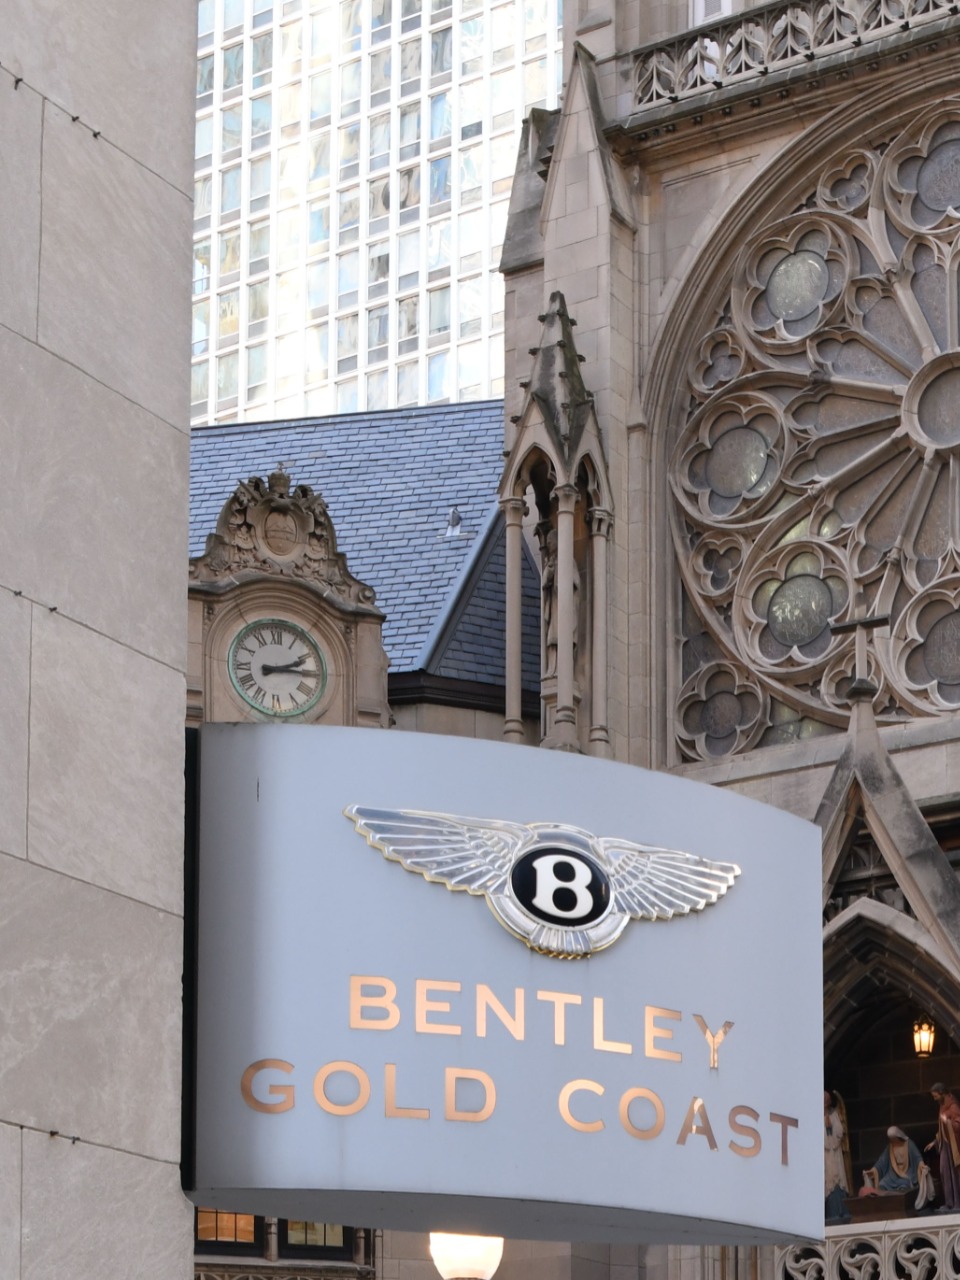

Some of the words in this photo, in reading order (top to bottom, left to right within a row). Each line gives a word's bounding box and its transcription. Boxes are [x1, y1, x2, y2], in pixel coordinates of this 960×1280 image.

[532, 854, 595, 919] B
[349, 974, 735, 1071] BENTLEY
[240, 1057, 497, 1123] GOLD
[557, 1078, 799, 1167] COAST
